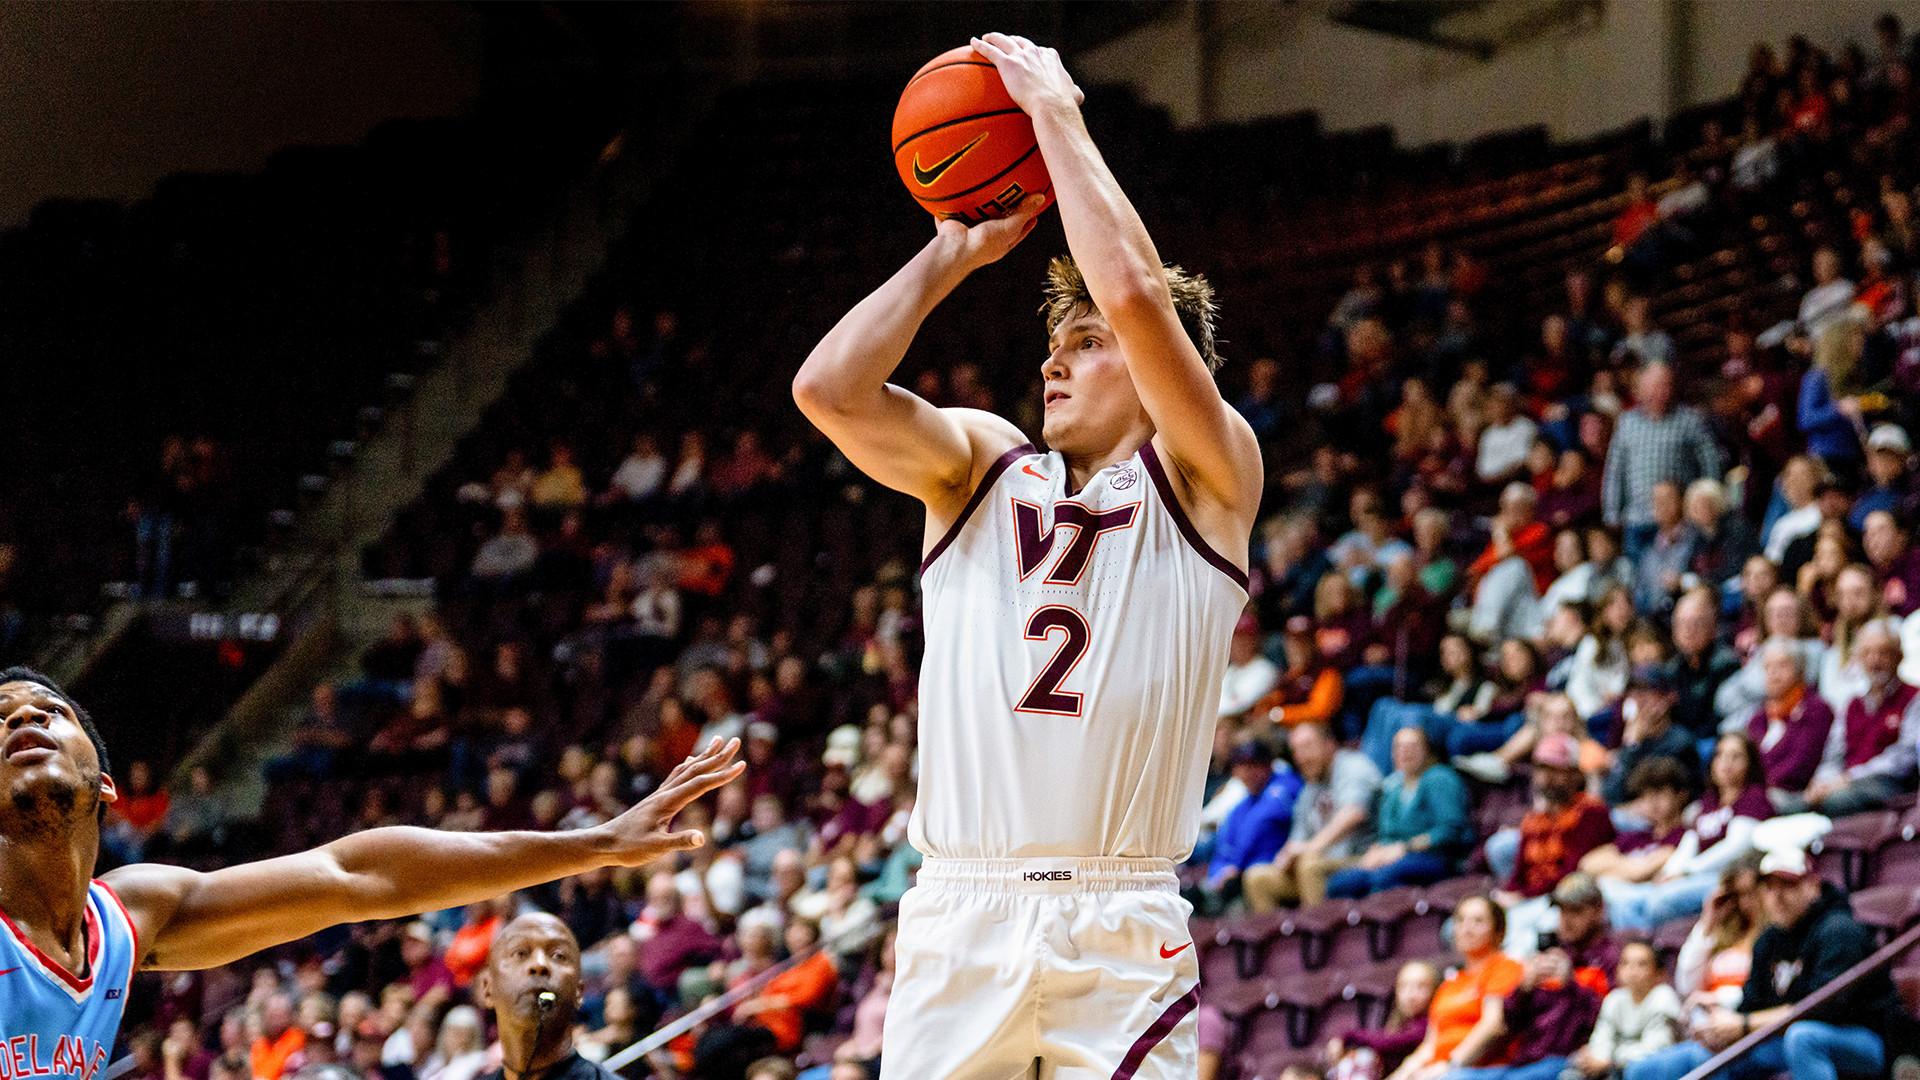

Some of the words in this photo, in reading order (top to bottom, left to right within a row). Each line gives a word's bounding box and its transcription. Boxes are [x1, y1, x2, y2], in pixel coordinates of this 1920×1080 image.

[1011, 498, 1142, 586] VT
[1014, 604, 1091, 717] 2
[1023, 870, 1072, 882] HOKIES
